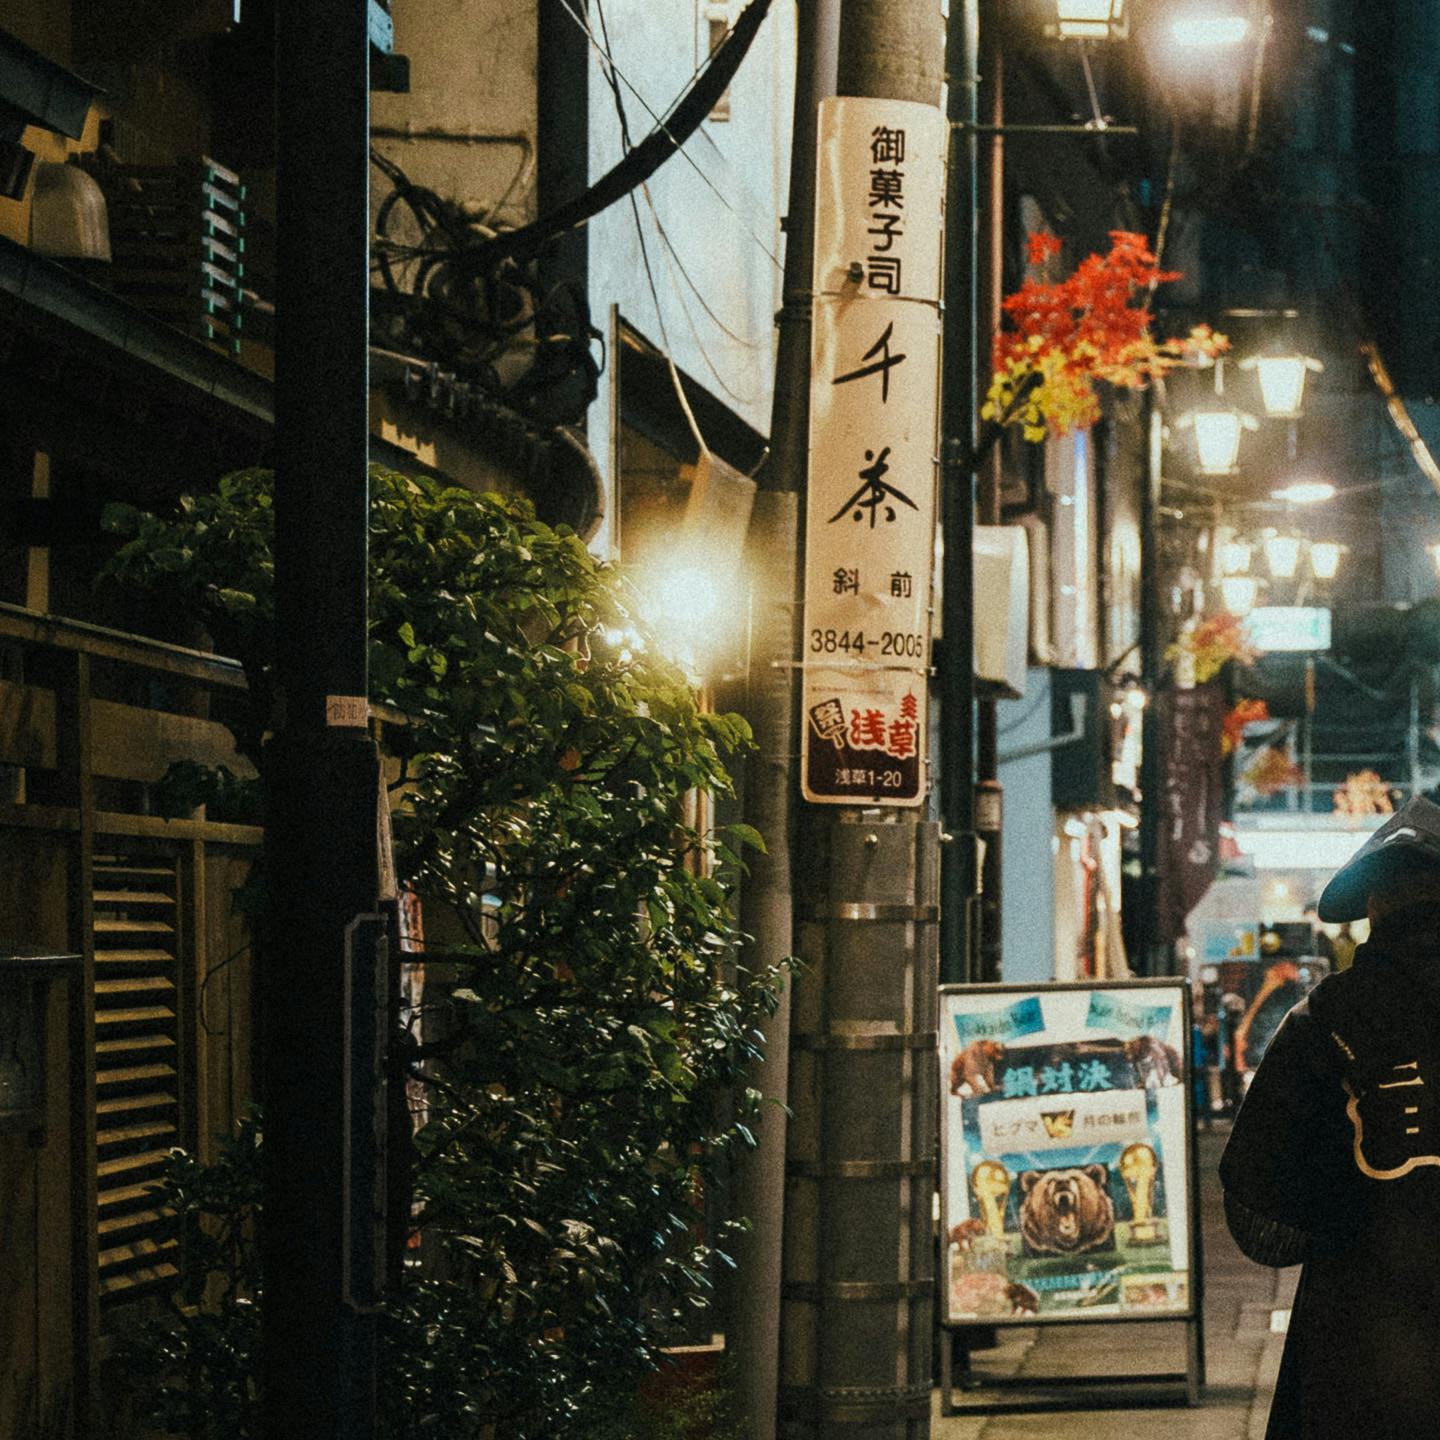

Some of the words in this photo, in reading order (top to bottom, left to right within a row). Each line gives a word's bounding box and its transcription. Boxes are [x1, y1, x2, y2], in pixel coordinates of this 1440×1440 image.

[866, 125, 905, 296] 御菓子司
[810, 628, 924, 659] 3844-2005
[850, 708, 916, 758] 浅草
